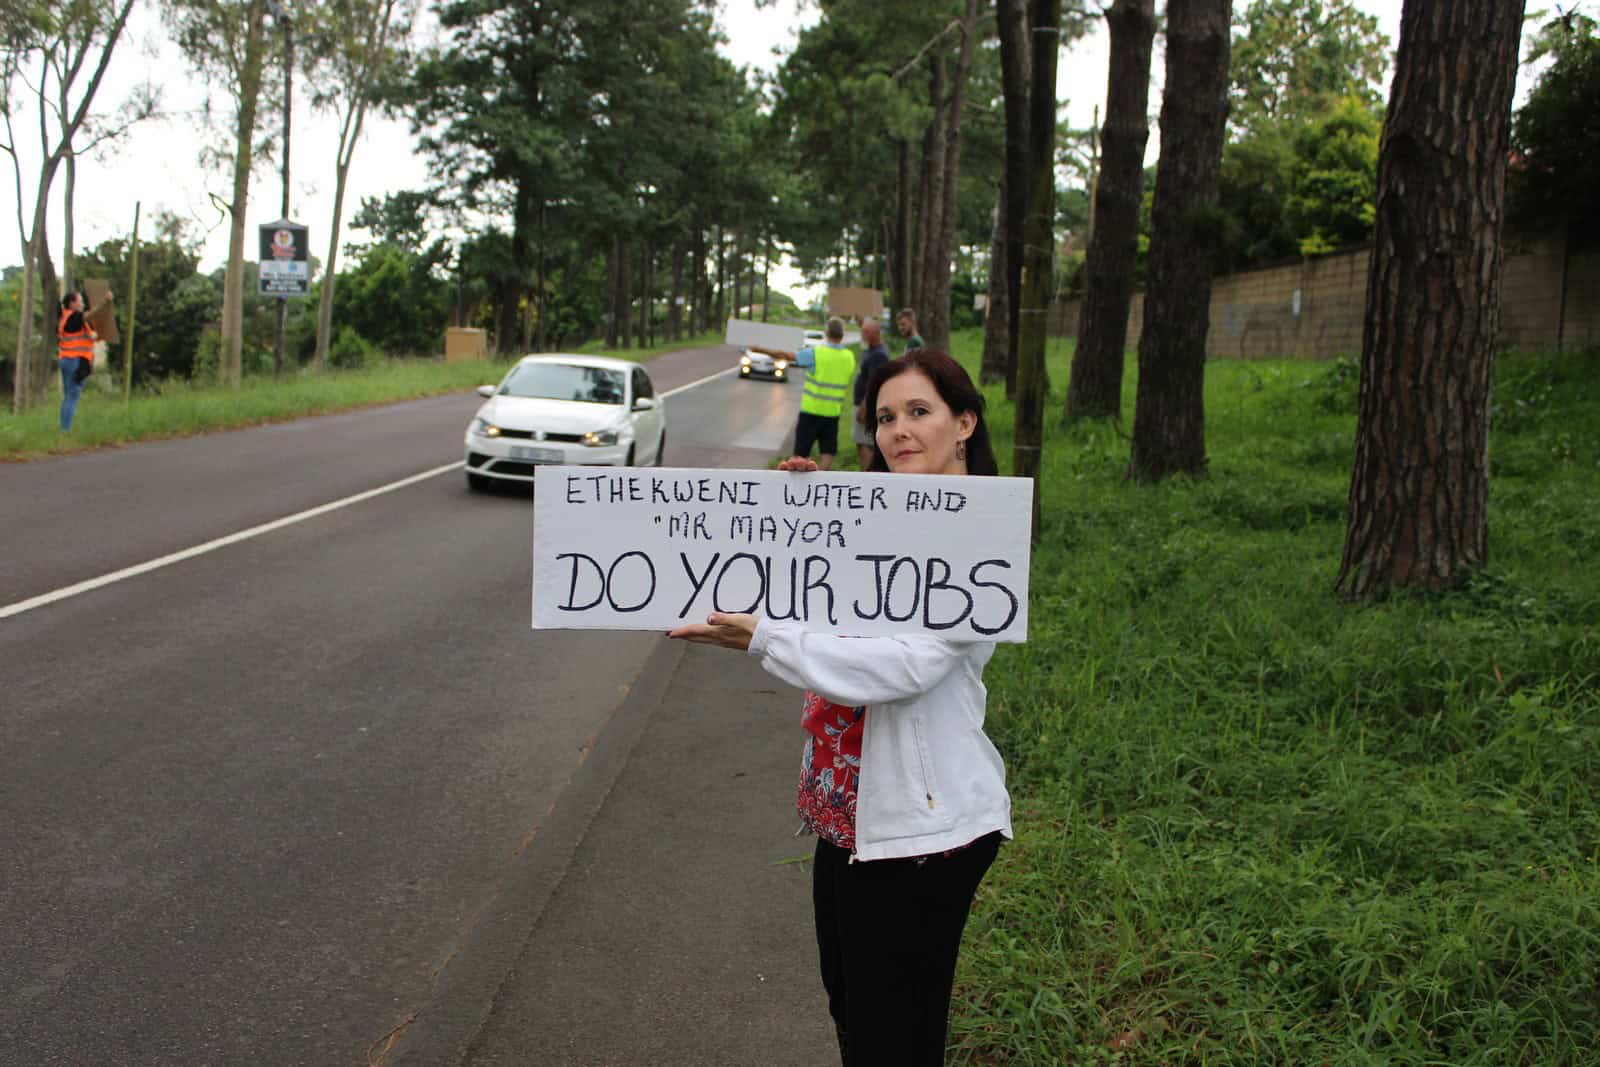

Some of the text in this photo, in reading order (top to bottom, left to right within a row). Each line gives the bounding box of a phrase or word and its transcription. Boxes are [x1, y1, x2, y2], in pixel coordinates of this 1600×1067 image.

[566, 474, 967, 513] ETHEKWENI WATER AND
[555, 550, 1019, 635] DO YOUR JOBS
